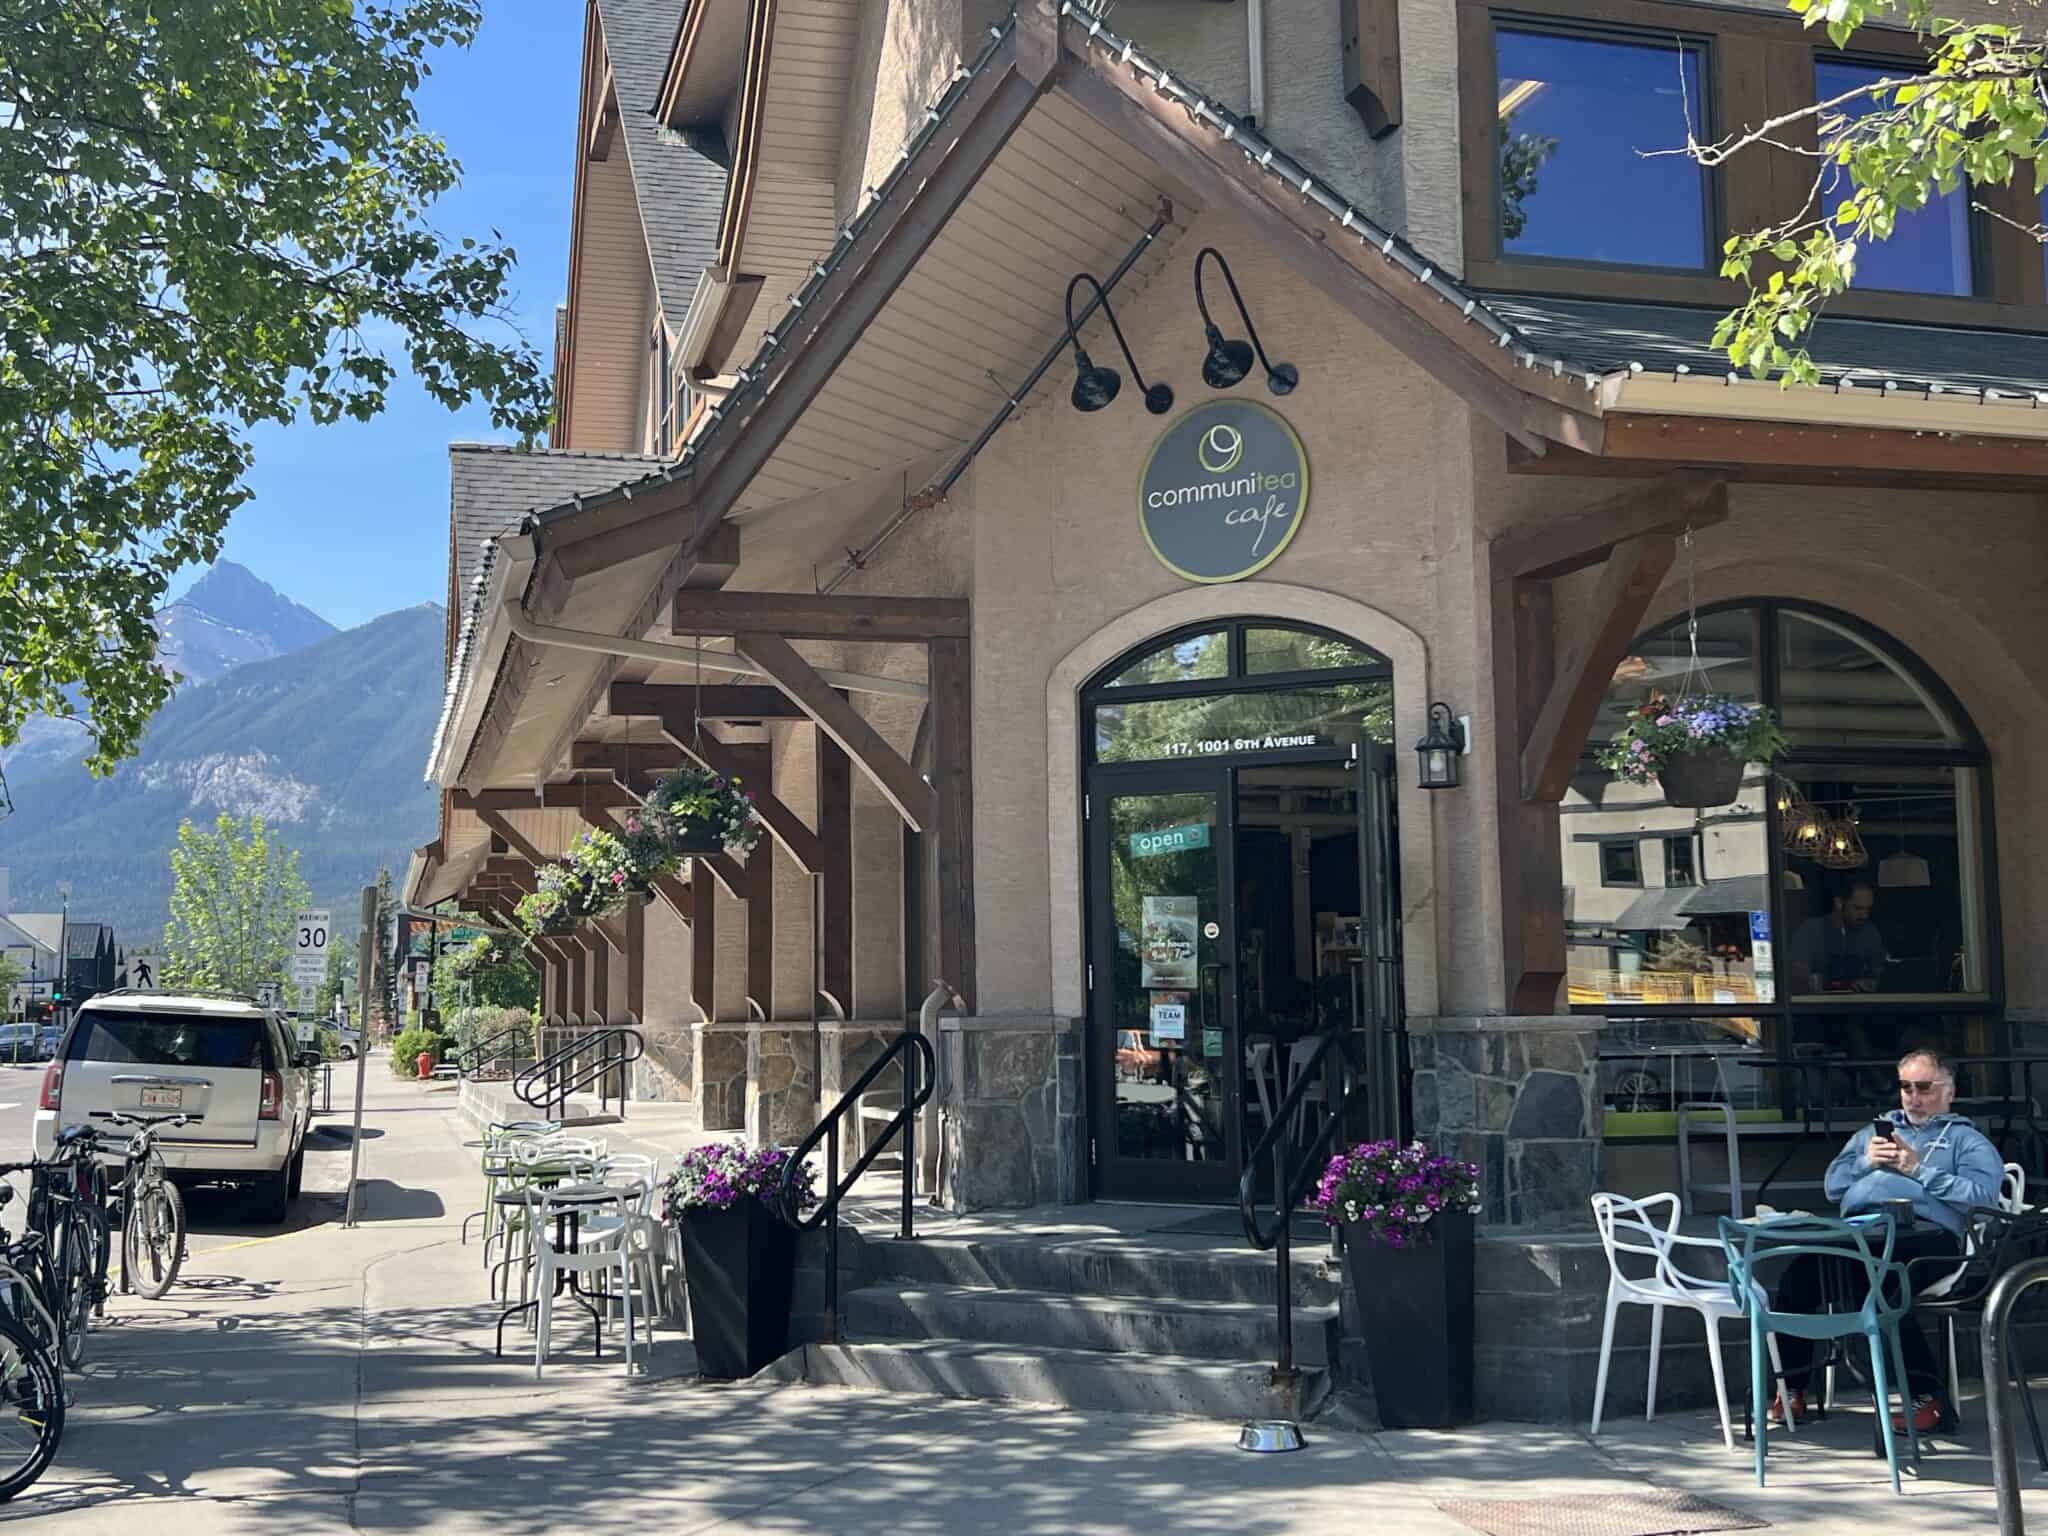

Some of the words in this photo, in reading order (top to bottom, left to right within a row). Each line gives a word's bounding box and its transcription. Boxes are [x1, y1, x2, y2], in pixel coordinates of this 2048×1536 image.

[1147, 472, 1296, 508] communitea
[1225, 494, 1289, 557] cafe
[1163, 742, 1193, 757] 117,
[1197, 739, 1230, 753] 1001
[1234, 738, 1260, 750] 6TH
[1263, 734, 1316, 749] AVENUE
[1140, 832, 1184, 852] open
[298, 927, 327, 948] 30
[1158, 1010, 1182, 1020] TEAM
